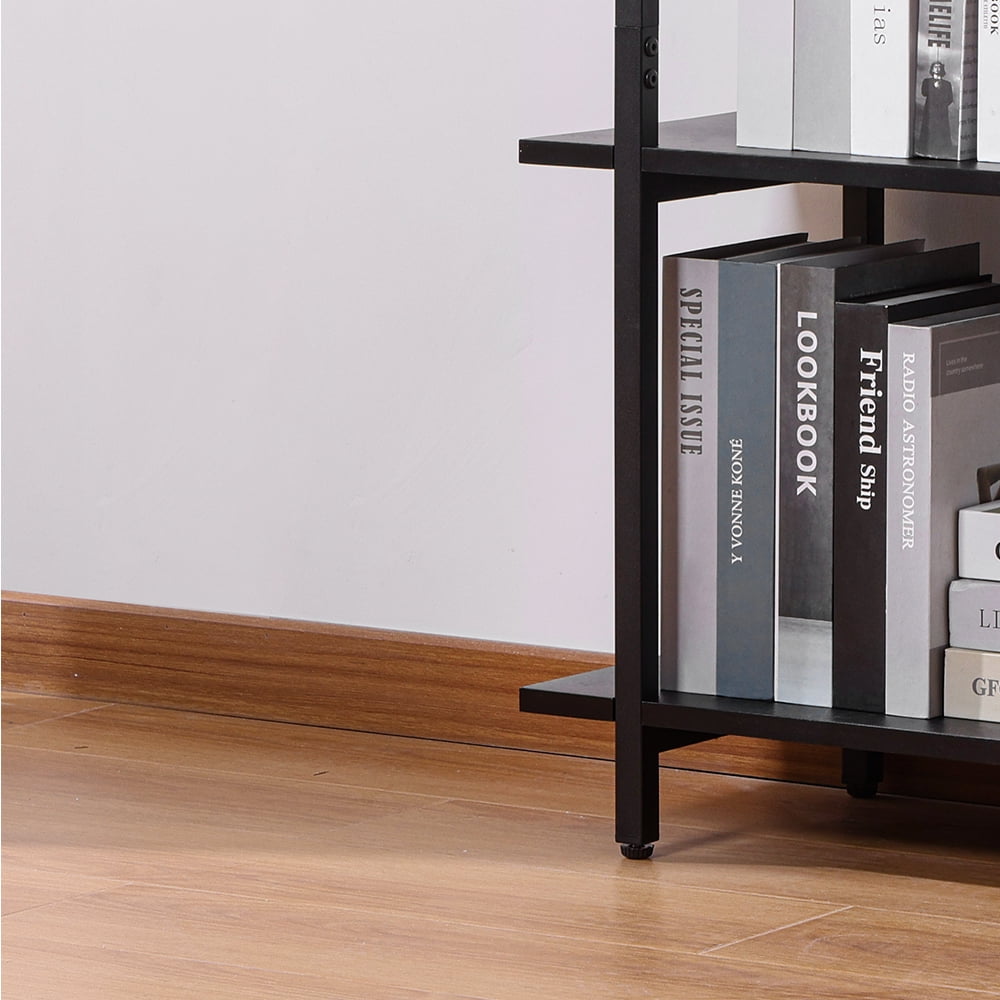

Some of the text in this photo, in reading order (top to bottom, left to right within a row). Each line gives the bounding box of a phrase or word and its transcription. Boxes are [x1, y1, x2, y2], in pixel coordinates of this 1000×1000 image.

[679, 288, 703, 455] SPECIAL ISSUE
[796, 311, 818, 496] LOOKBOOK
[856, 347, 883, 511] Friend Ship
[902, 352, 915, 550] RADIO ASTRONOMER
[729, 438, 743, 564] Y VONNE KONÉ
